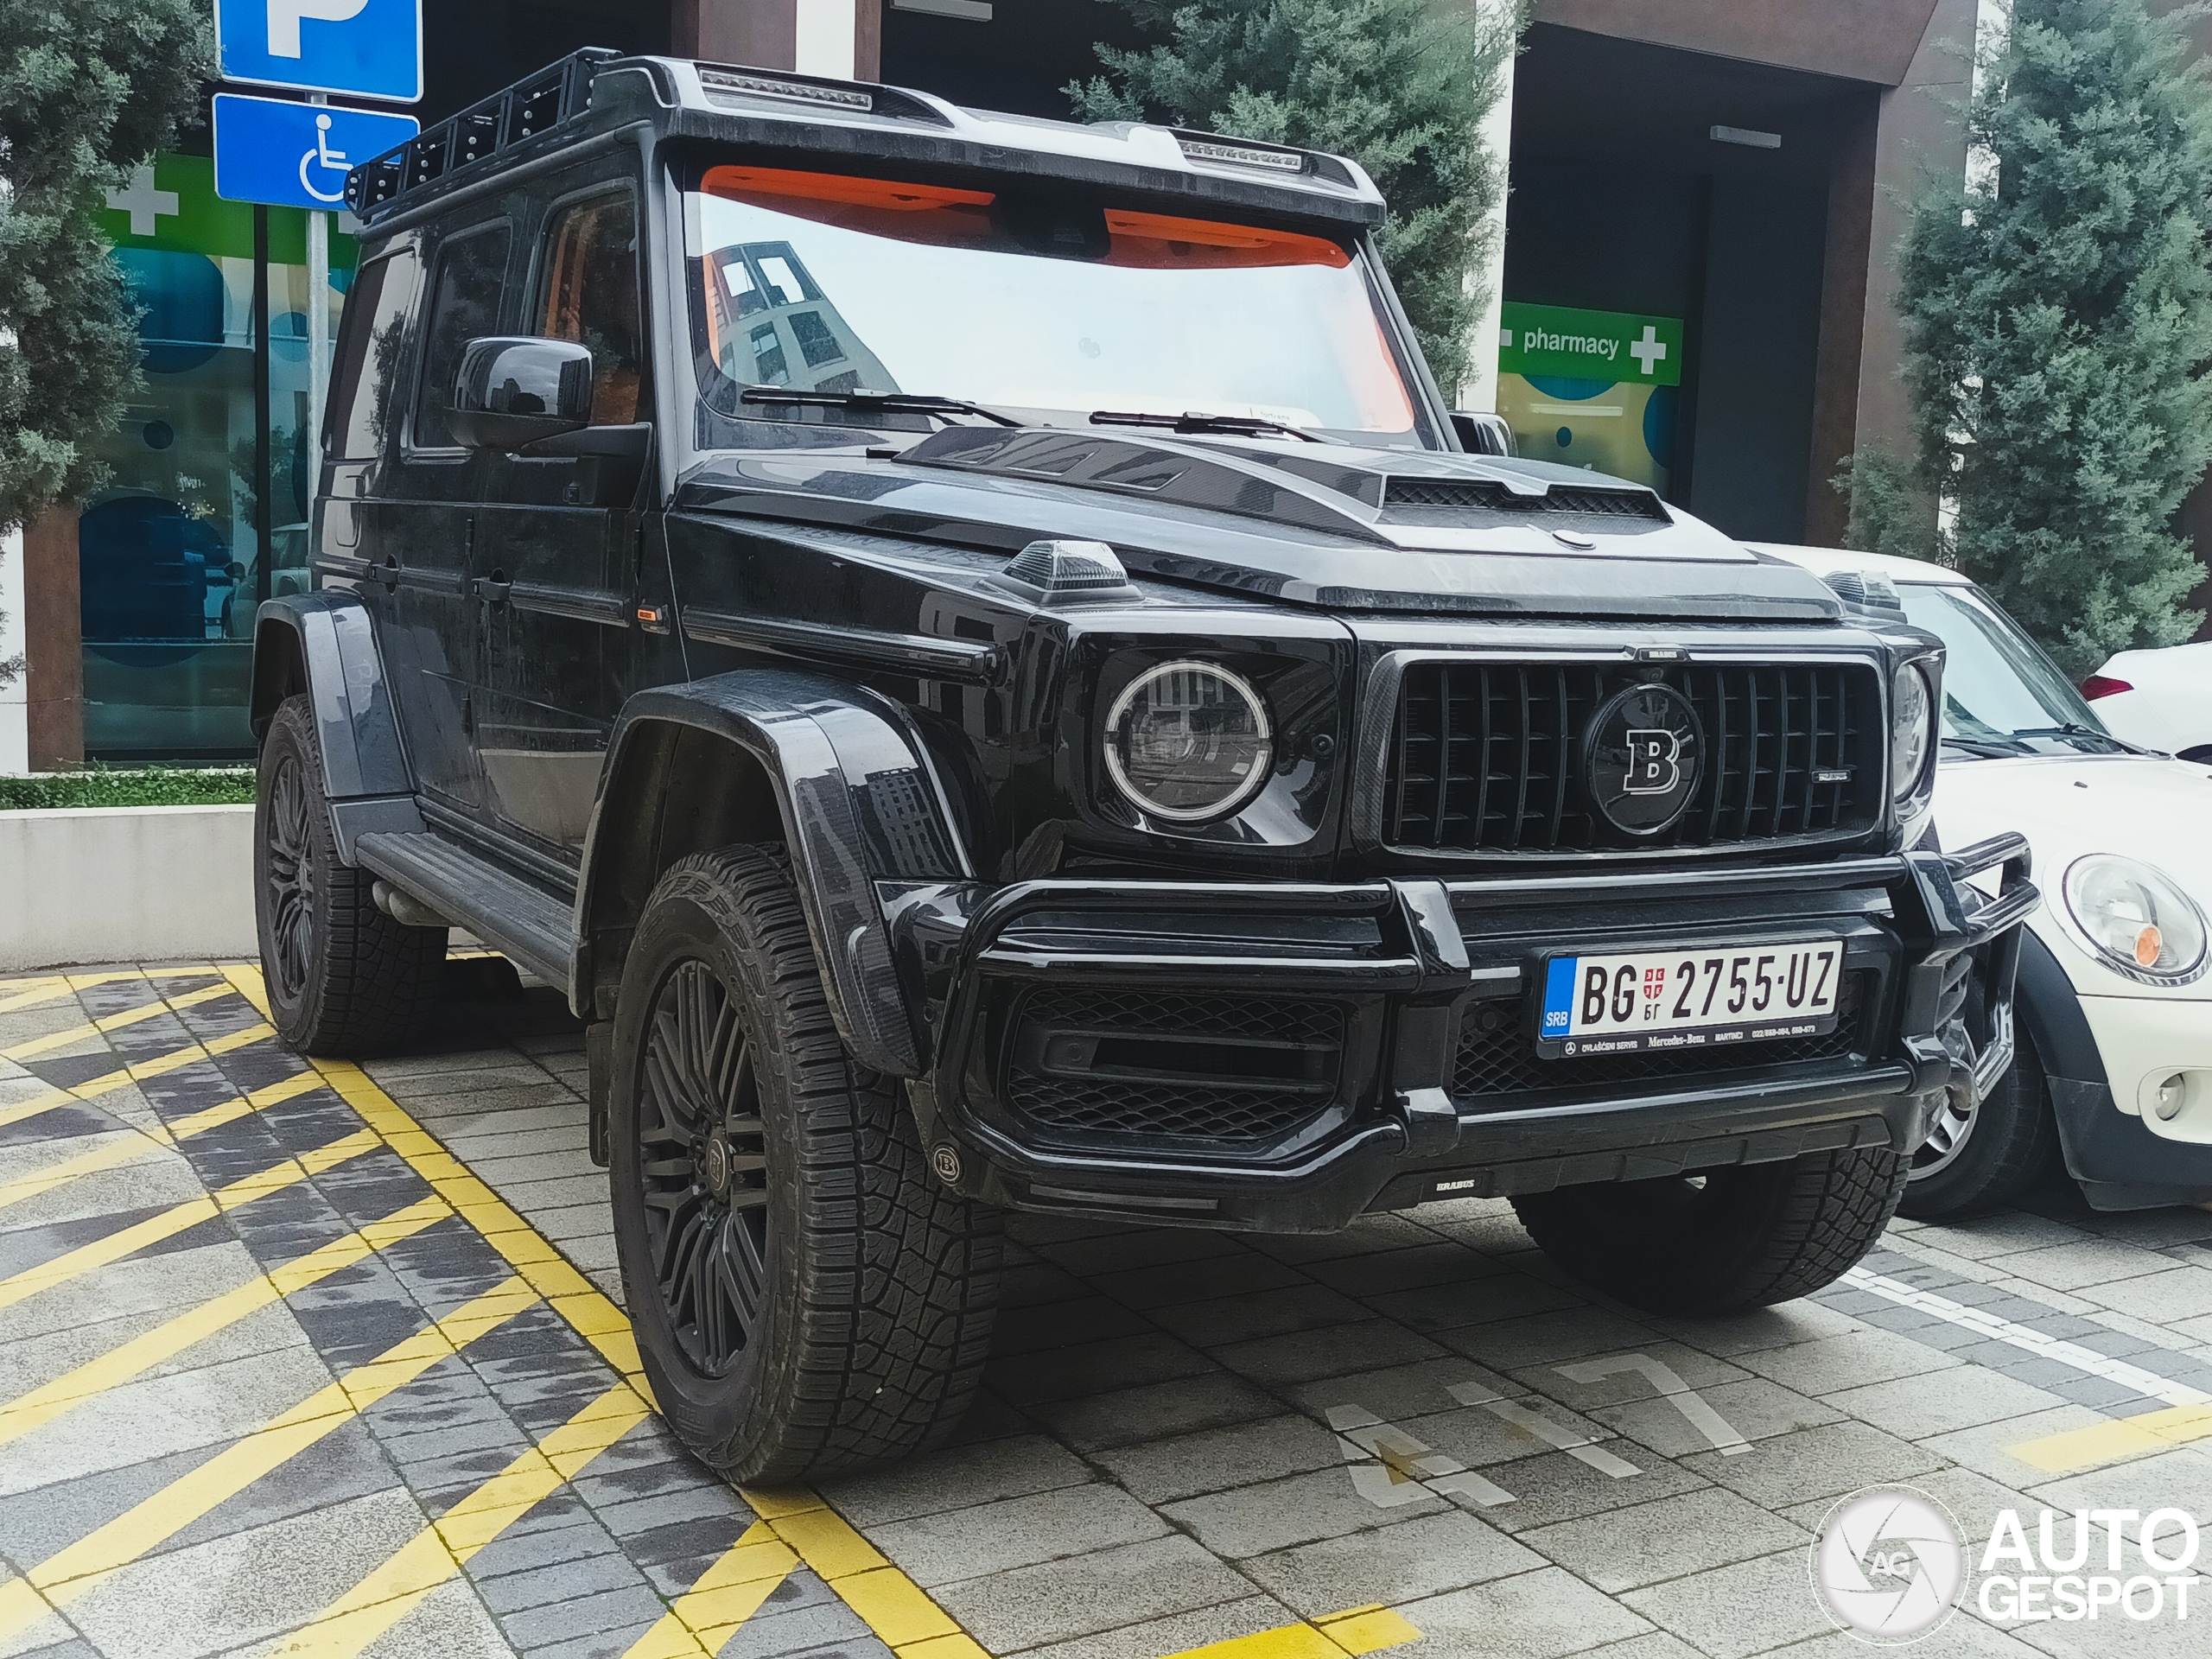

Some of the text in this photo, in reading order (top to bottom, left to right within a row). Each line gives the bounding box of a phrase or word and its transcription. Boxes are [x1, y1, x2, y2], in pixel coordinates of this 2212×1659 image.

[1524, 327, 1618, 360] pharmacy
[1624, 729, 1680, 795] B
[1581, 965, 1637, 1025] BG
[1545, 1011, 1568, 1027] SRB
[1647, 1033, 1706, 1048] Mercedes-Benz
[938, 1154, 957, 1176] B
